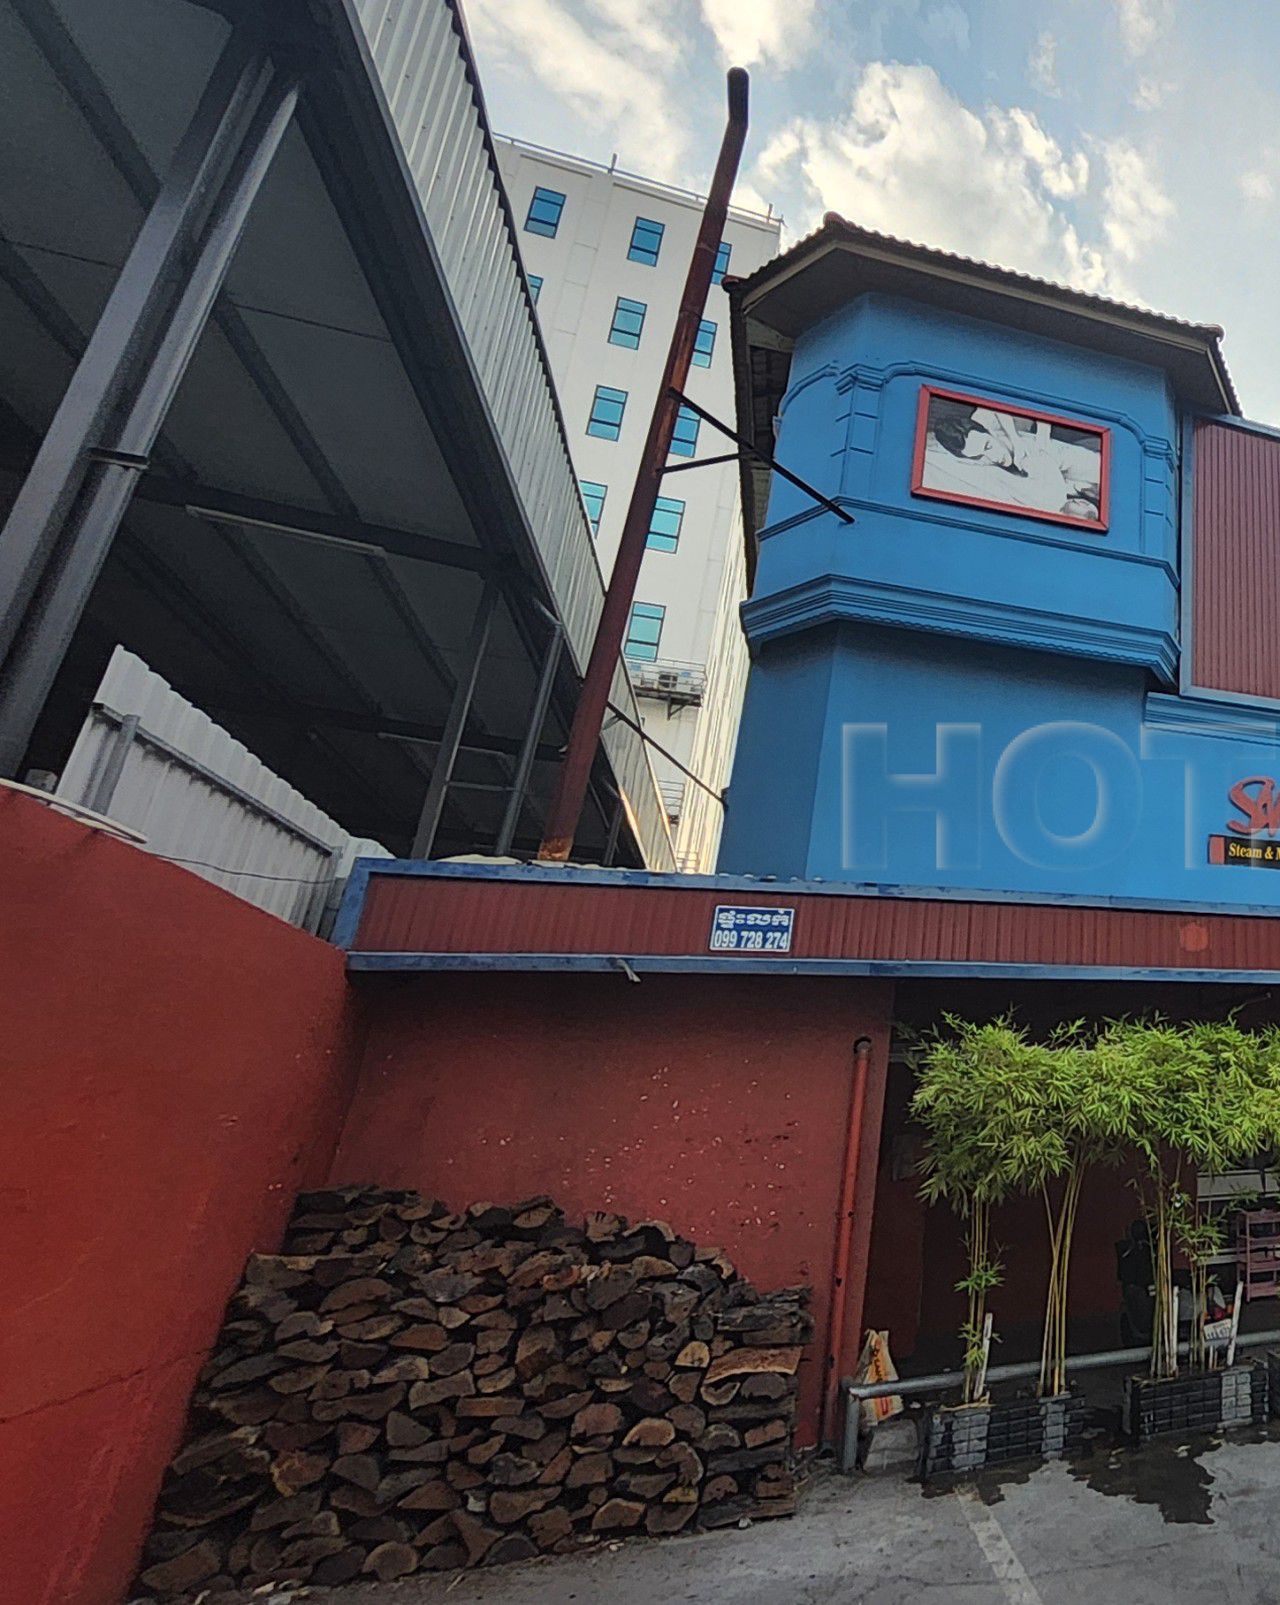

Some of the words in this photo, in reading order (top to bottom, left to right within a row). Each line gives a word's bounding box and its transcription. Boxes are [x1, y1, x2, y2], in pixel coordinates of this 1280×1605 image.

[1228, 842, 1262, 859] Steam
[1264, 847, 1274, 859] &
[713, 930, 738, 948] 099
[740, 931, 763, 948] 728
[764, 932, 789, 949] 274
